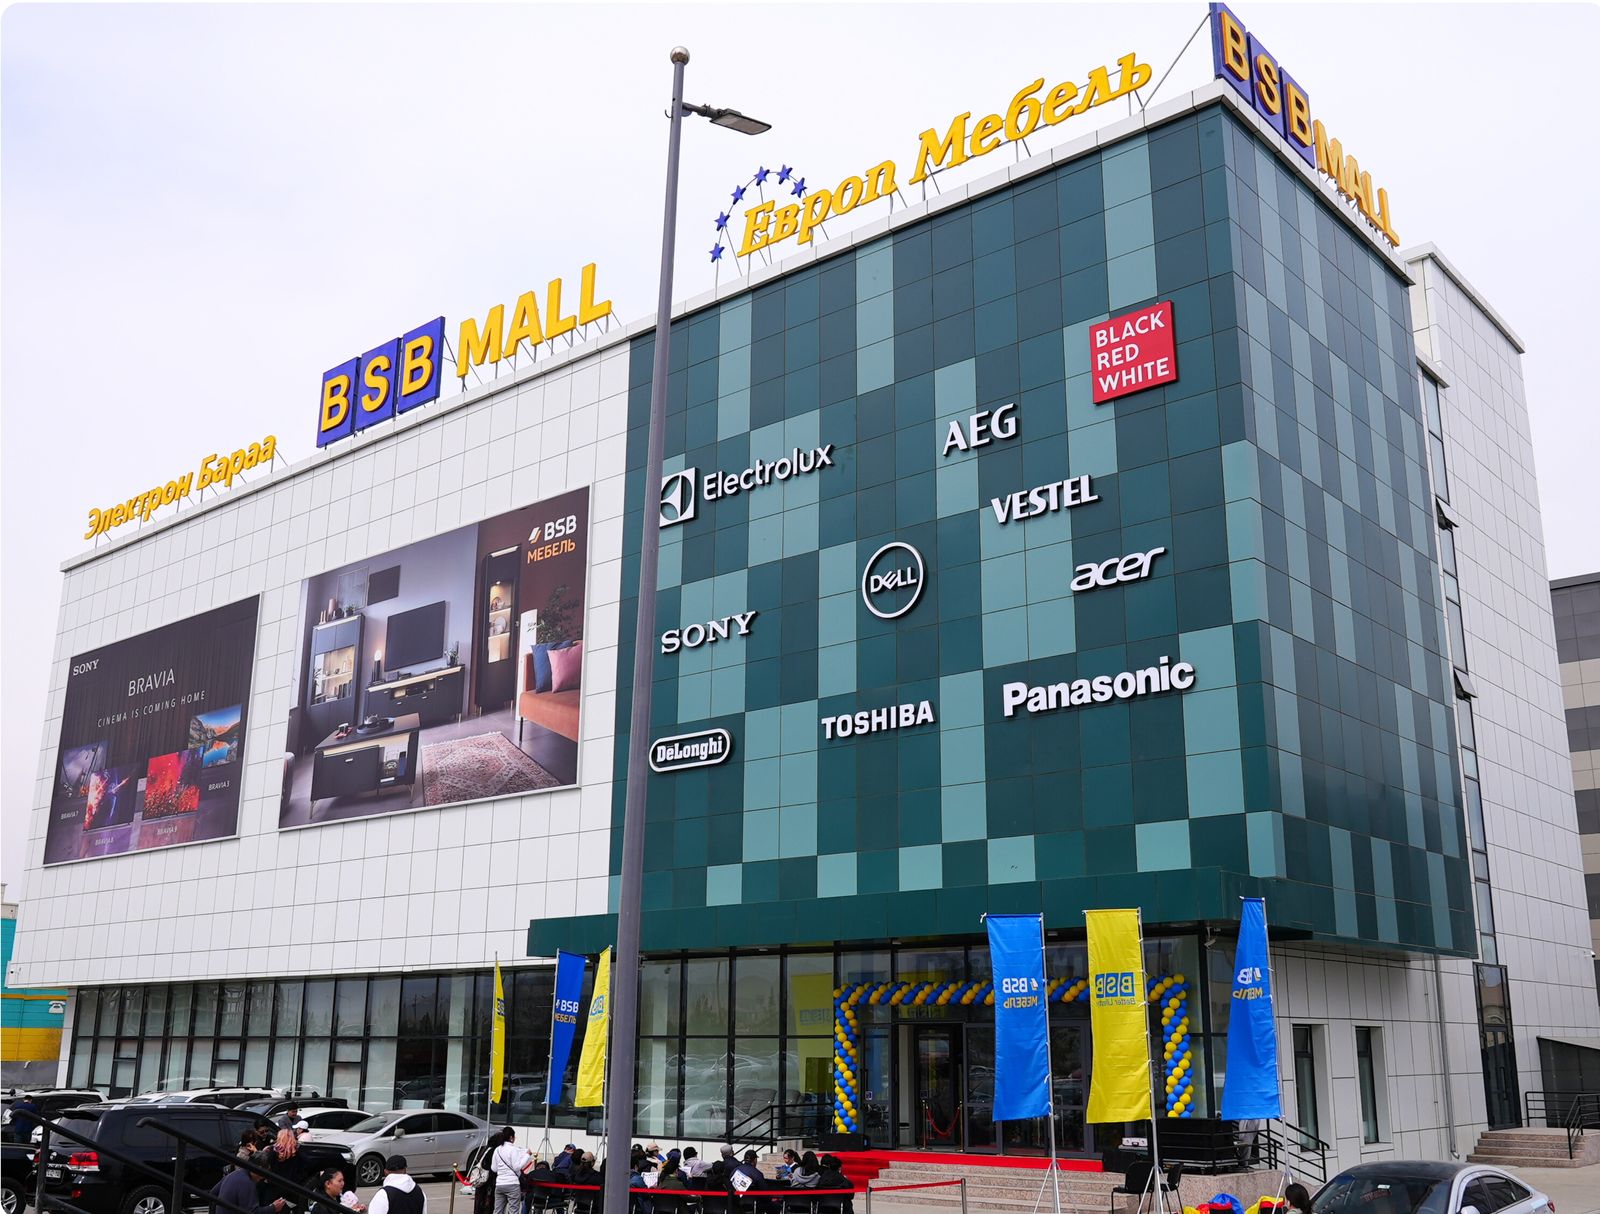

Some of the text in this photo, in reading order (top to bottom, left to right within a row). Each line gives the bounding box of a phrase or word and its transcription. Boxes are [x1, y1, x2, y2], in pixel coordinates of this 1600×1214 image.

[1219, 10, 1400, 247] BSB MALL
[737, 52, 1152, 257] Европ Мебель
[320, 262, 612, 432] BSB MALL
[1095, 310, 1165, 348] BLACK
[1097, 343, 1139, 371] RED
[1098, 357, 1170, 393] WHITE
[942, 403, 1018, 456] AEG
[84, 435, 276, 540] Электрон Бараа
[703, 443, 835, 501] Electrolux
[990, 474, 1100, 524] VESTEL
[544, 514, 577, 541] BSB
[527, 539, 576, 564] МЕБЕЛЬ
[1070, 546, 1166, 592] acer
[870, 566, 918, 593] DELL
[660, 610, 756, 654] SONY
[73, 659, 99, 676] SONY
[128, 668, 175, 697] BRAVIA
[1002, 655, 1196, 717] Panasonic
[97, 690, 205, 728] CINEMA IS COMING HOME
[821, 700, 936, 740] TOSHIBA
[208, 781, 227, 791] BRAVIA
[561, 1000, 579, 1013] BSB
